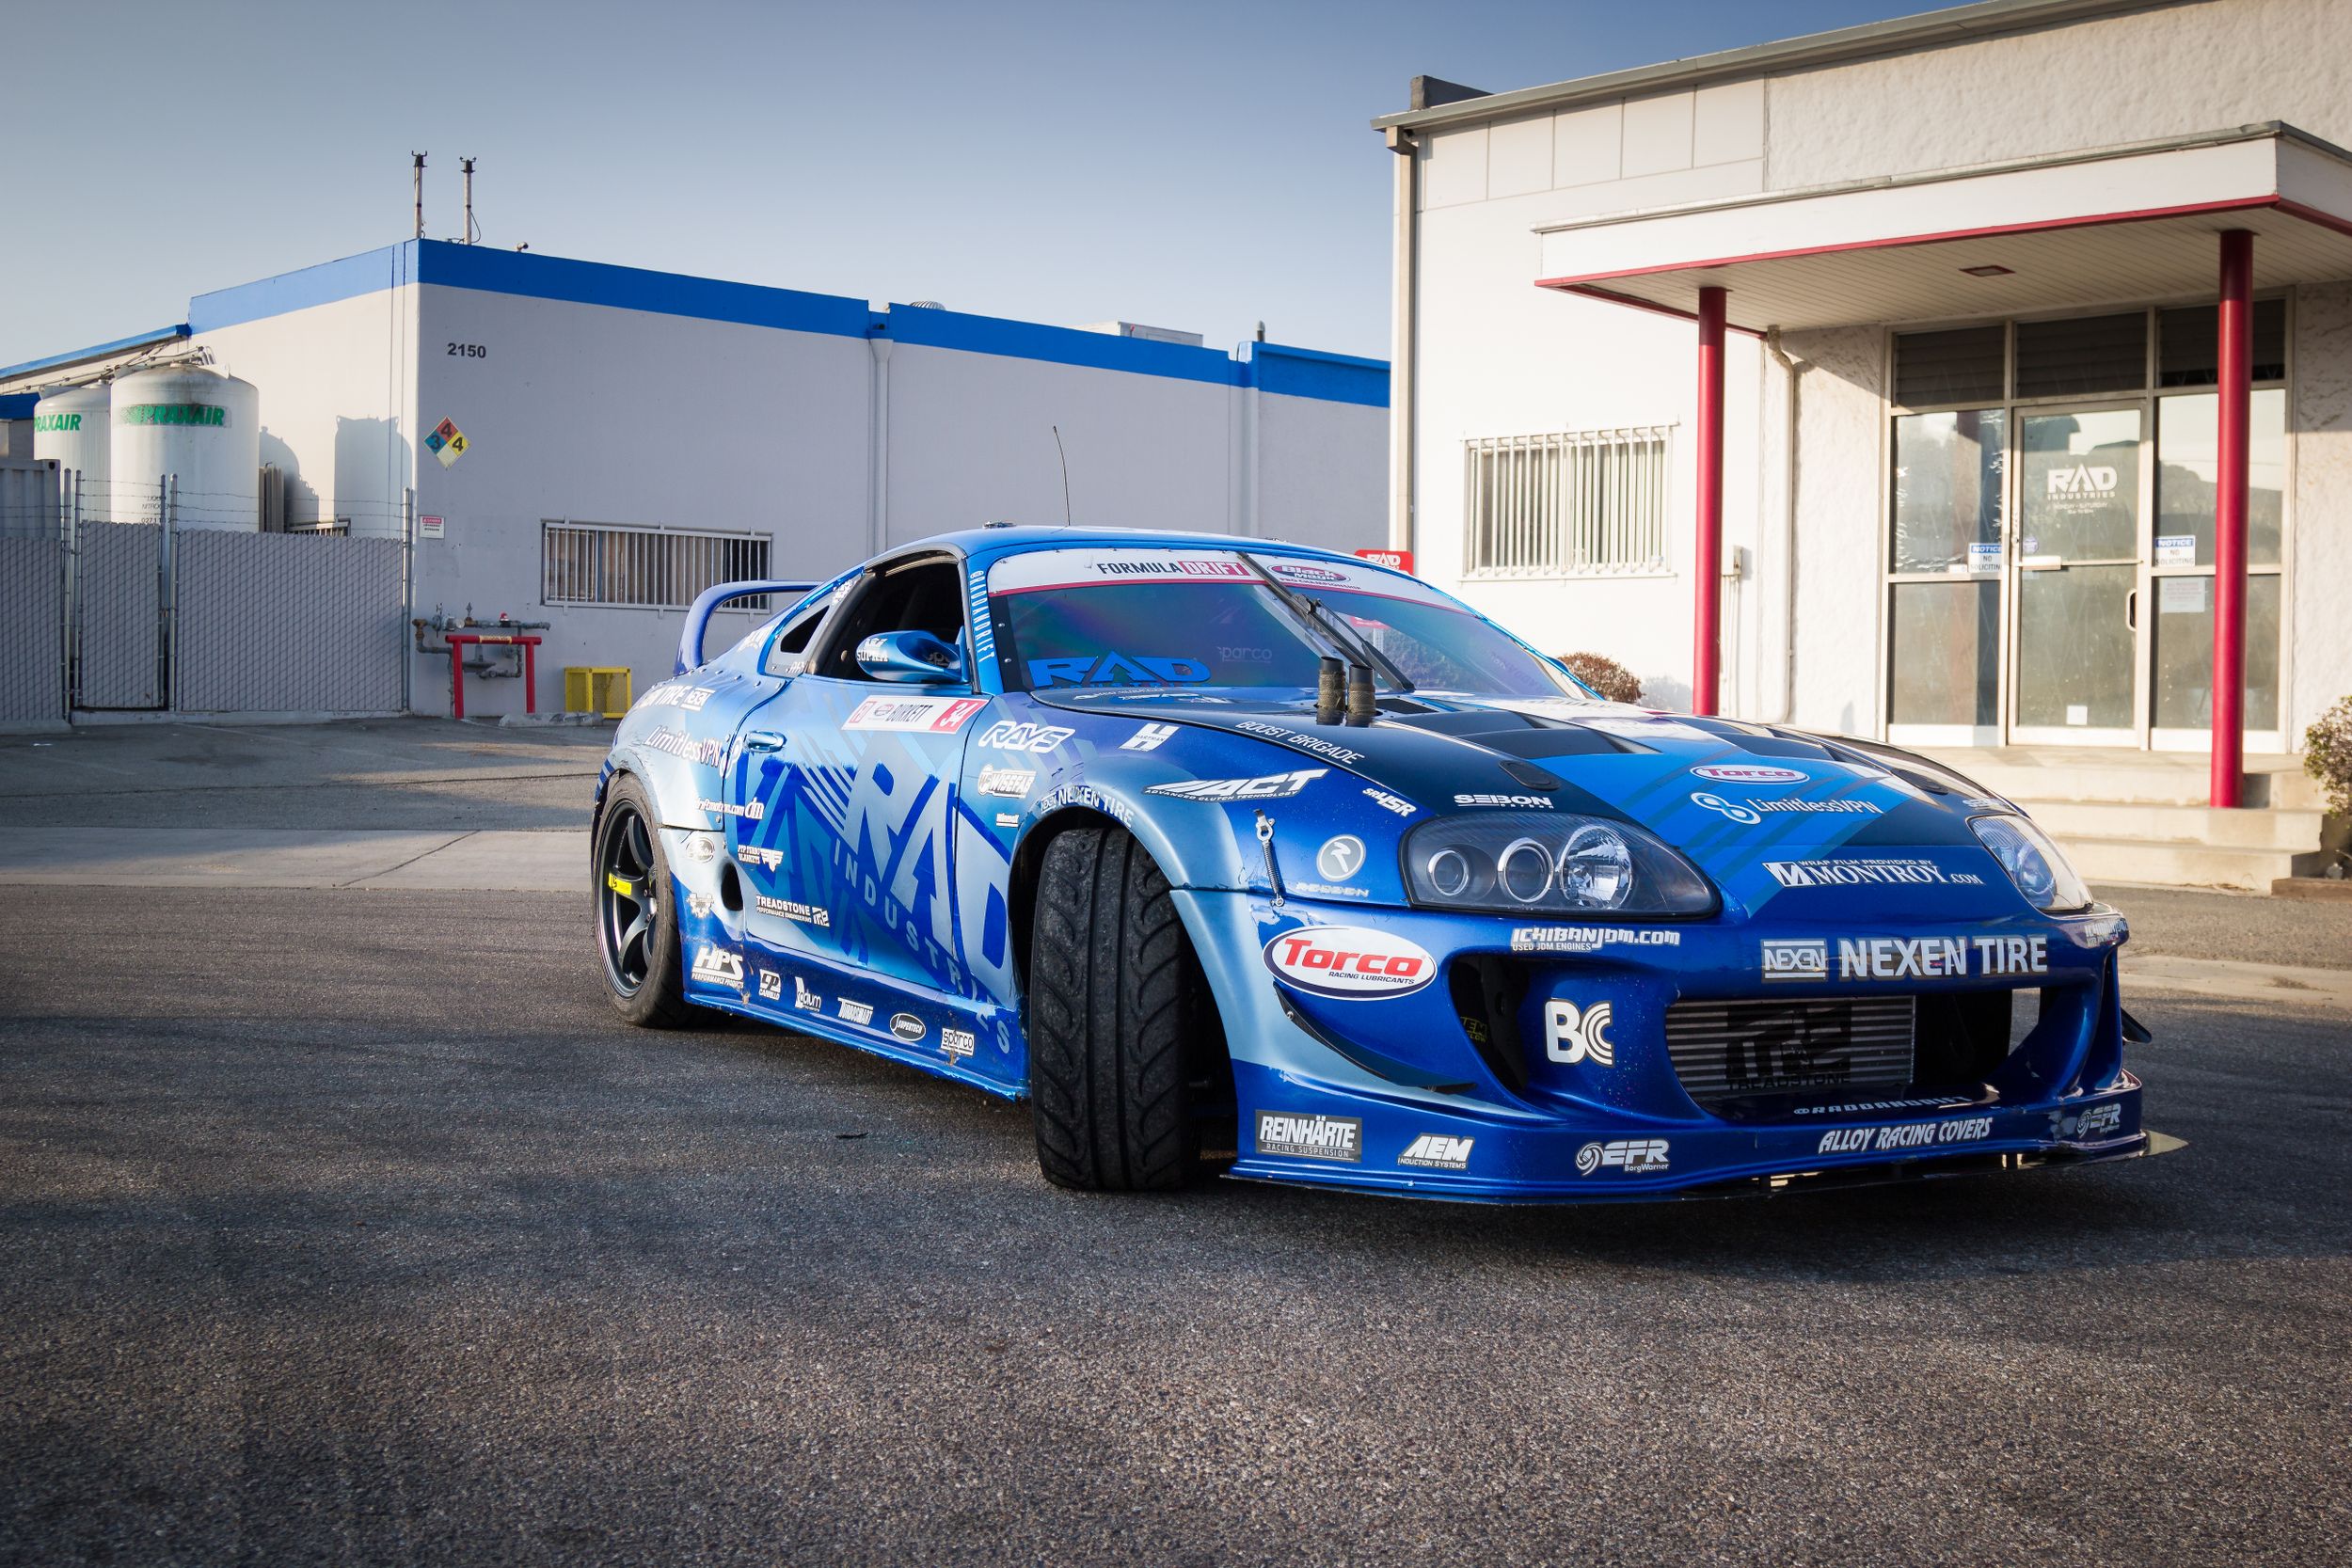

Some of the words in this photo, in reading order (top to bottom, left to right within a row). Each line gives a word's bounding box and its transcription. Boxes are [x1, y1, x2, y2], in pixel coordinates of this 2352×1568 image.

[447, 342, 486, 358] 2150
[440, 423, 453, 437] 4
[431, 436, 441, 450] 3
[453, 436, 464, 451] 4
[2047, 464, 2117, 493] RAD
[2047, 491, 2116, 500] INDUSTRIES
[1096, 562, 1184, 575] FORMULA
[1180, 562, 1248, 575] DRIFT
[1281, 564, 1336, 578] Black
[1216, 646, 1273, 662] parco
[1027, 651, 1212, 689] RAD
[644, 725, 723, 768] LimitlessVPN
[977, 721, 1075, 753] RAYS
[1234, 721, 1295, 738] BOOST
[1287, 734, 1365, 765] BRIGADE
[1181, 768, 1329, 797] ACT
[1701, 768, 1796, 778] Torco
[1145, 789, 1197, 800] ADVANCED
[1236, 790, 1298, 800] TECHNOLOGY
[1058, 785, 1101, 808] NEXEN
[1103, 793, 1135, 829] TIRE
[1746, 799, 1885, 815] LimitlessVPN
[1804, 864, 1949, 884] MONTROY
[755, 895, 811, 916] TREADSTONE
[1512, 942, 1534, 952] USED
[1536, 942, 1554, 951] JDM
[1557, 942, 1592, 952] ENGINES
[1840, 939, 1967, 978] NEXEN
[1975, 935, 2048, 974] TIRE
[693, 946, 744, 981] HPS
[1284, 938, 1423, 977] Torco
[1328, 971, 1359, 980] RACING
[1360, 974, 1415, 985] LUBRICANTS
[897, 1019, 923, 1035] SUPERTECH
[1546, 999, 1613, 1067] BC
[943, 1031, 974, 1050] sparco
[1260, 1115, 1358, 1149] REINHÄRTE
[1818, 1128, 1878, 1155] ALLOY
[1874, 1123, 1937, 1150] RACING
[1938, 1117, 1994, 1142] COVERS
[1265, 1142, 1295, 1153] RACING
[1298, 1146, 1350, 1159] SUSPENSION
[1403, 1135, 1474, 1163] AEM
[1601, 1139, 1670, 1165] EFR
[1397, 1157, 1434, 1167] INDUCTION
[1435, 1161, 1468, 1169] SYSTEMS
[1624, 1164, 1669, 1173] BorgWarner
